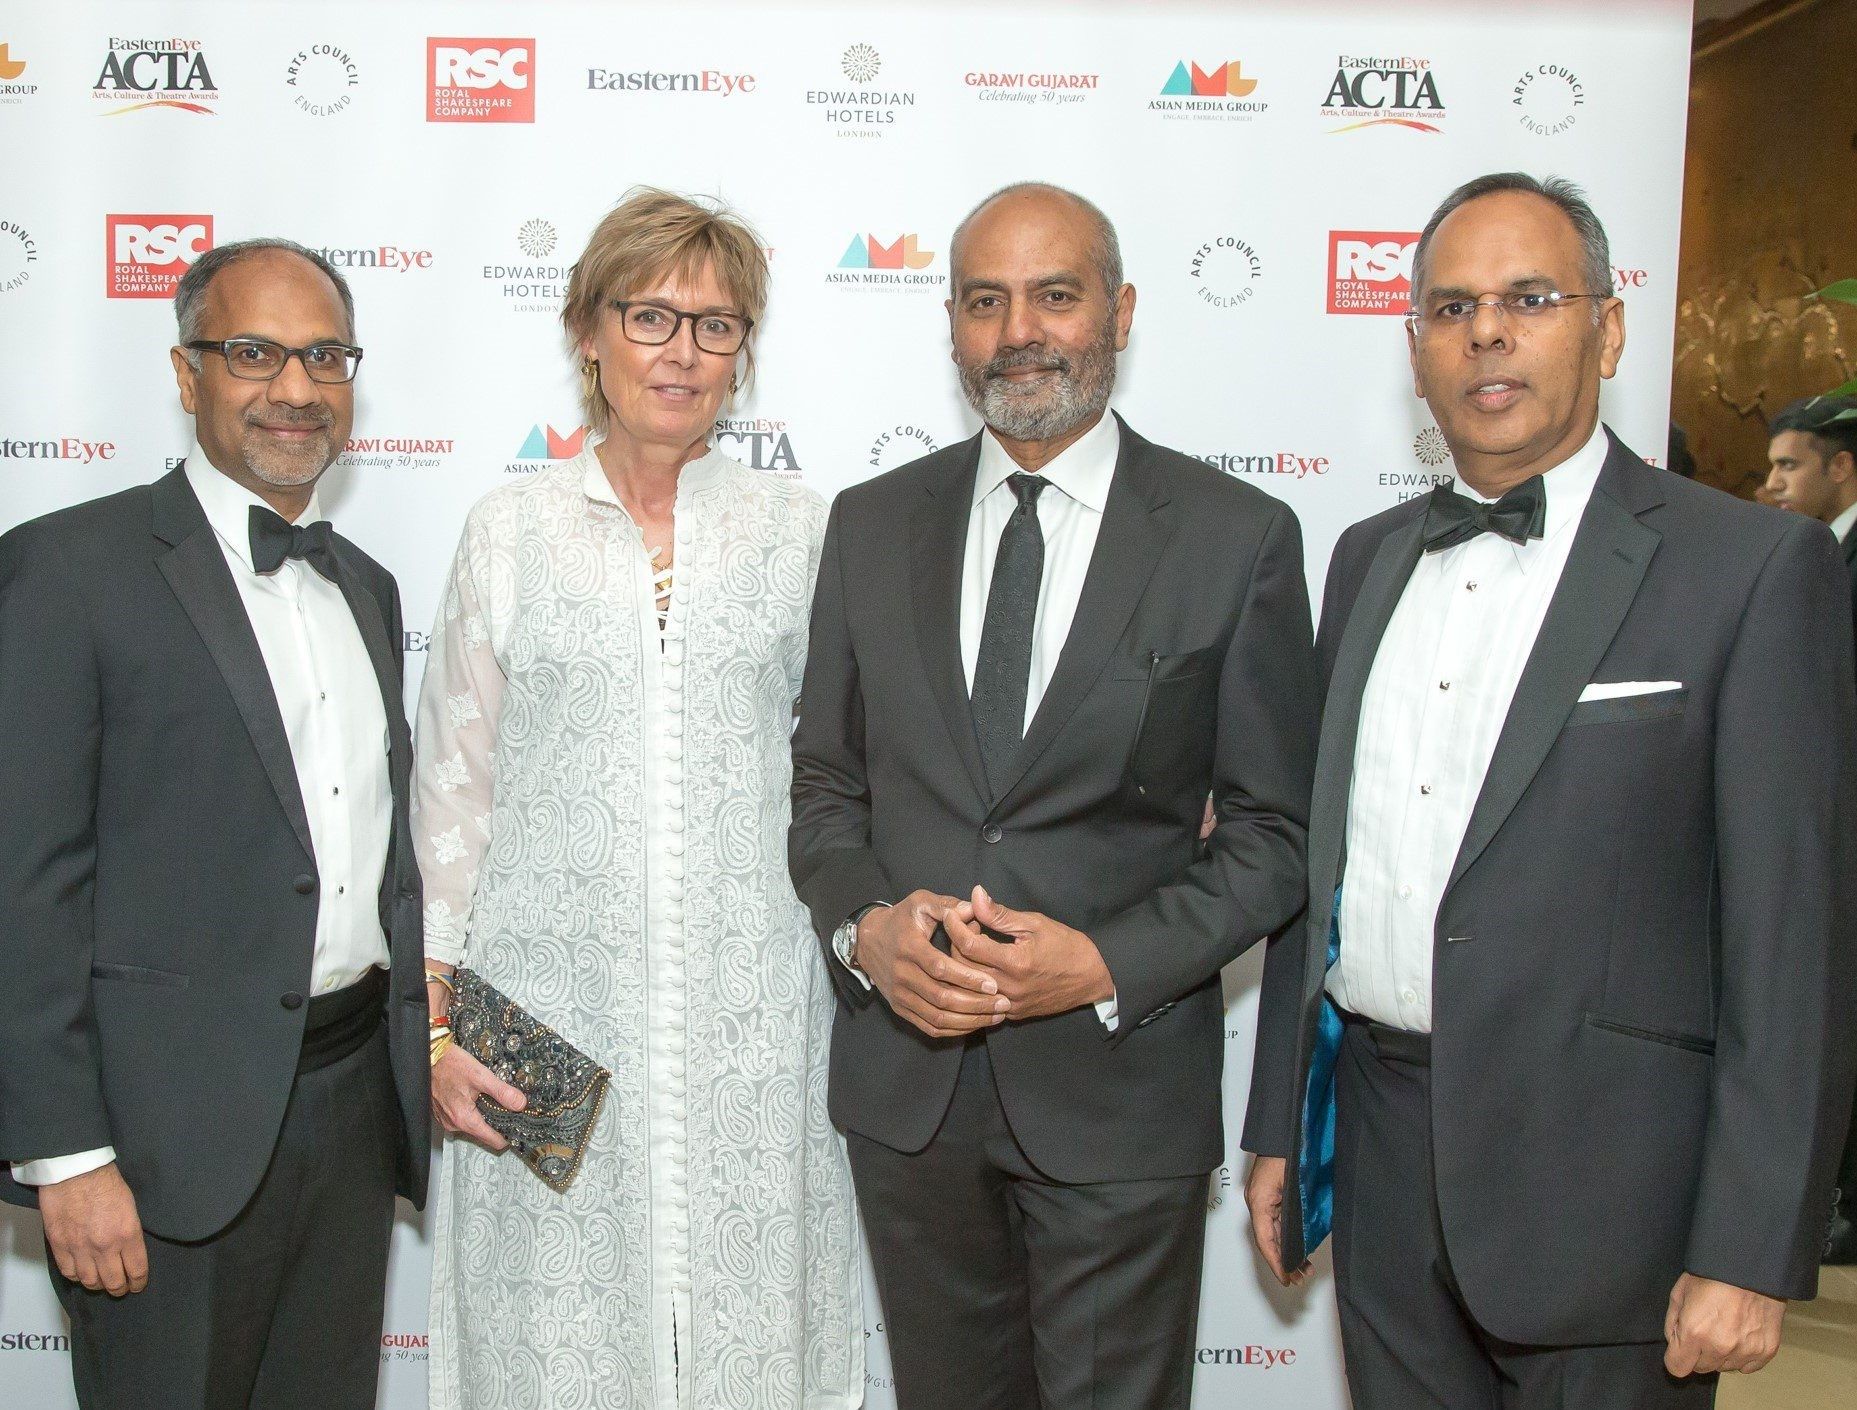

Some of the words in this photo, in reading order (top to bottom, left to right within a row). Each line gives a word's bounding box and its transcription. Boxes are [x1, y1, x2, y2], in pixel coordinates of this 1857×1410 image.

[108, 37, 201, 51] EasternEye
[286, 52, 307, 86] ARTS
[312, 44, 358, 86] COUNCIL
[435, 47, 528, 89] RSC
[1338, 55, 1430, 69] EasternEye
[93, 51, 218, 91] ACTA
[587, 68, 756, 97] EasternEye
[965, 72, 1024, 87] GARAVI
[1513, 71, 1533, 105] ARTS
[1539, 65, 1584, 106] COUNCIL
[114, 92, 144, 100] Culture
[146, 92, 153, 100] &
[156, 92, 186, 100] Theatre
[188, 92, 219, 100] Awards
[435, 89, 470, 98] ROYAL
[1321, 69, 1445, 109] ACTA
[435, 98, 513, 107] SHAKESPEARE
[806, 91, 915, 105] EDWARDIAN
[979, 89, 1037, 104] Celebrating
[1040, 91, 1055, 102] 50
[1056, 93, 1086, 105] years
[295, 95, 351, 116] ENGLAND
[435, 107, 491, 116] COMPANY
[1148, 100, 1182, 110] ASIAN
[1185, 101, 1223, 111] MEDIA
[1227, 102, 1268, 112] GROUP
[827, 109, 895, 123] HOTELS
[1341, 108, 1372, 117] Culture
[1382, 109, 1414, 118] Theatre
[1415, 110, 1446, 118] Awards
[1520, 115, 1576, 136] ENGLAND
[837, 130, 882, 138] LONDON
[0, 221, 37, 263] OUNCIL
[115, 224, 206, 265] RSC
[311, 246, 433, 273] ternEye
[1191, 243, 1211, 277] ARTS
[1216, 237, 1261, 278] COUNCIL
[115, 265, 149, 274] ROYAL
[0, 271, 30, 293] LAND
[115, 275, 183, 283] SHAKESPEA
[825, 274, 860, 284] ASIAN
[863, 275, 901, 284] MEDIA
[904, 275, 946, 285] GROUP
[1335, 282, 1370, 290] ROYAL
[115, 284, 170, 292] COMPANY
[1198, 287, 1253, 307] ENGLAND
[514, 304, 560, 312] LONDON
[1335, 300, 1390, 309] COMPANY
[714, 418, 787, 432] sternEye
[0, 438, 116, 464] ternEye
[343, 438, 380, 453] RAVI
[869, 432, 891, 467] ARTS
[895, 426, 939, 454] COUNC
[335, 454, 393, 469] Celebrating
[396, 456, 411, 467] 50
[412, 458, 441, 469] years
[504, 464, 539, 473] ASIAN
[1379, 473, 1453, 486] EDWARD
[1, 1331, 70, 1351] stern
[381, 1334, 429, 1348] GUJAR
[394, 1350, 409, 1361] 50
[1196, 1345, 1296, 1370] ernEye
